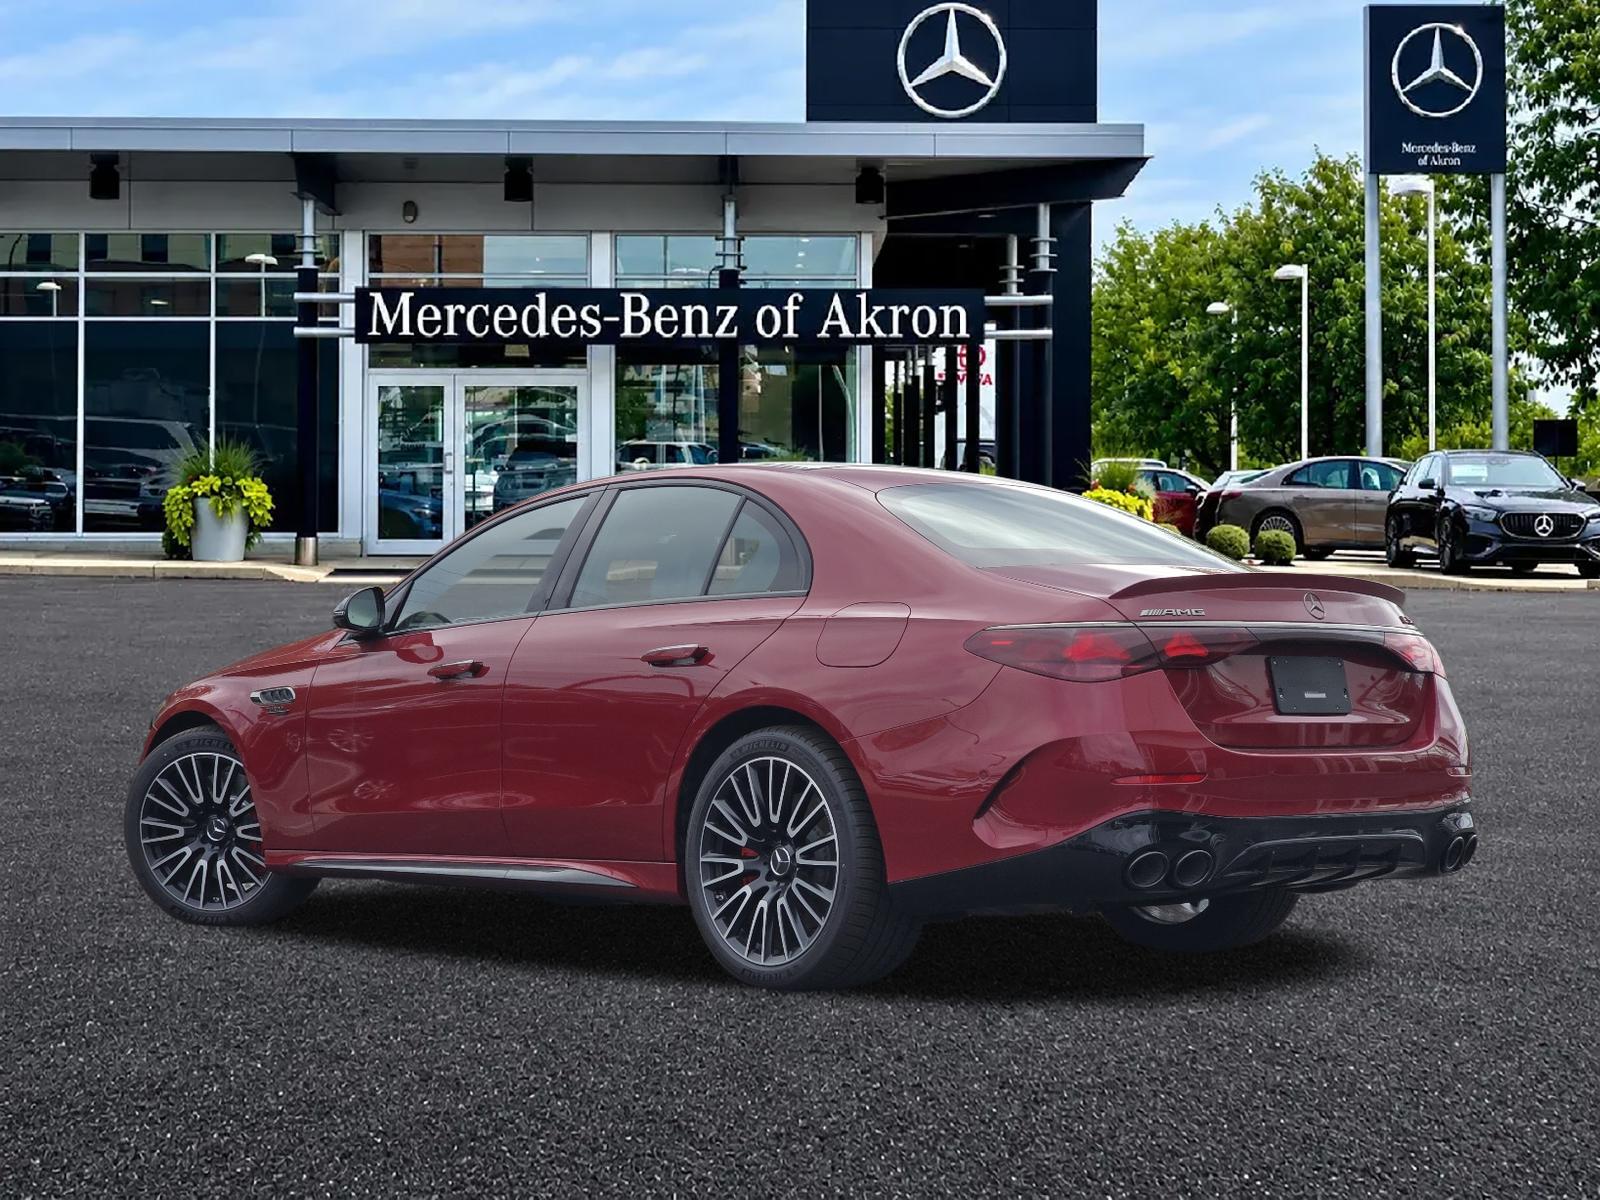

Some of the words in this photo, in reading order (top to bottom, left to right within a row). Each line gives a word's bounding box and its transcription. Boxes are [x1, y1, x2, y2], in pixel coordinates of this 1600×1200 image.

[1401, 141, 1476, 154] Mercedes-Benz
[1417, 154, 1428, 166] of
[1430, 154, 1461, 166] Akron
[367, 291, 739, 339] Mercedes-Benz
[755, 291, 804, 339] of
[816, 291, 970, 339] Akron
